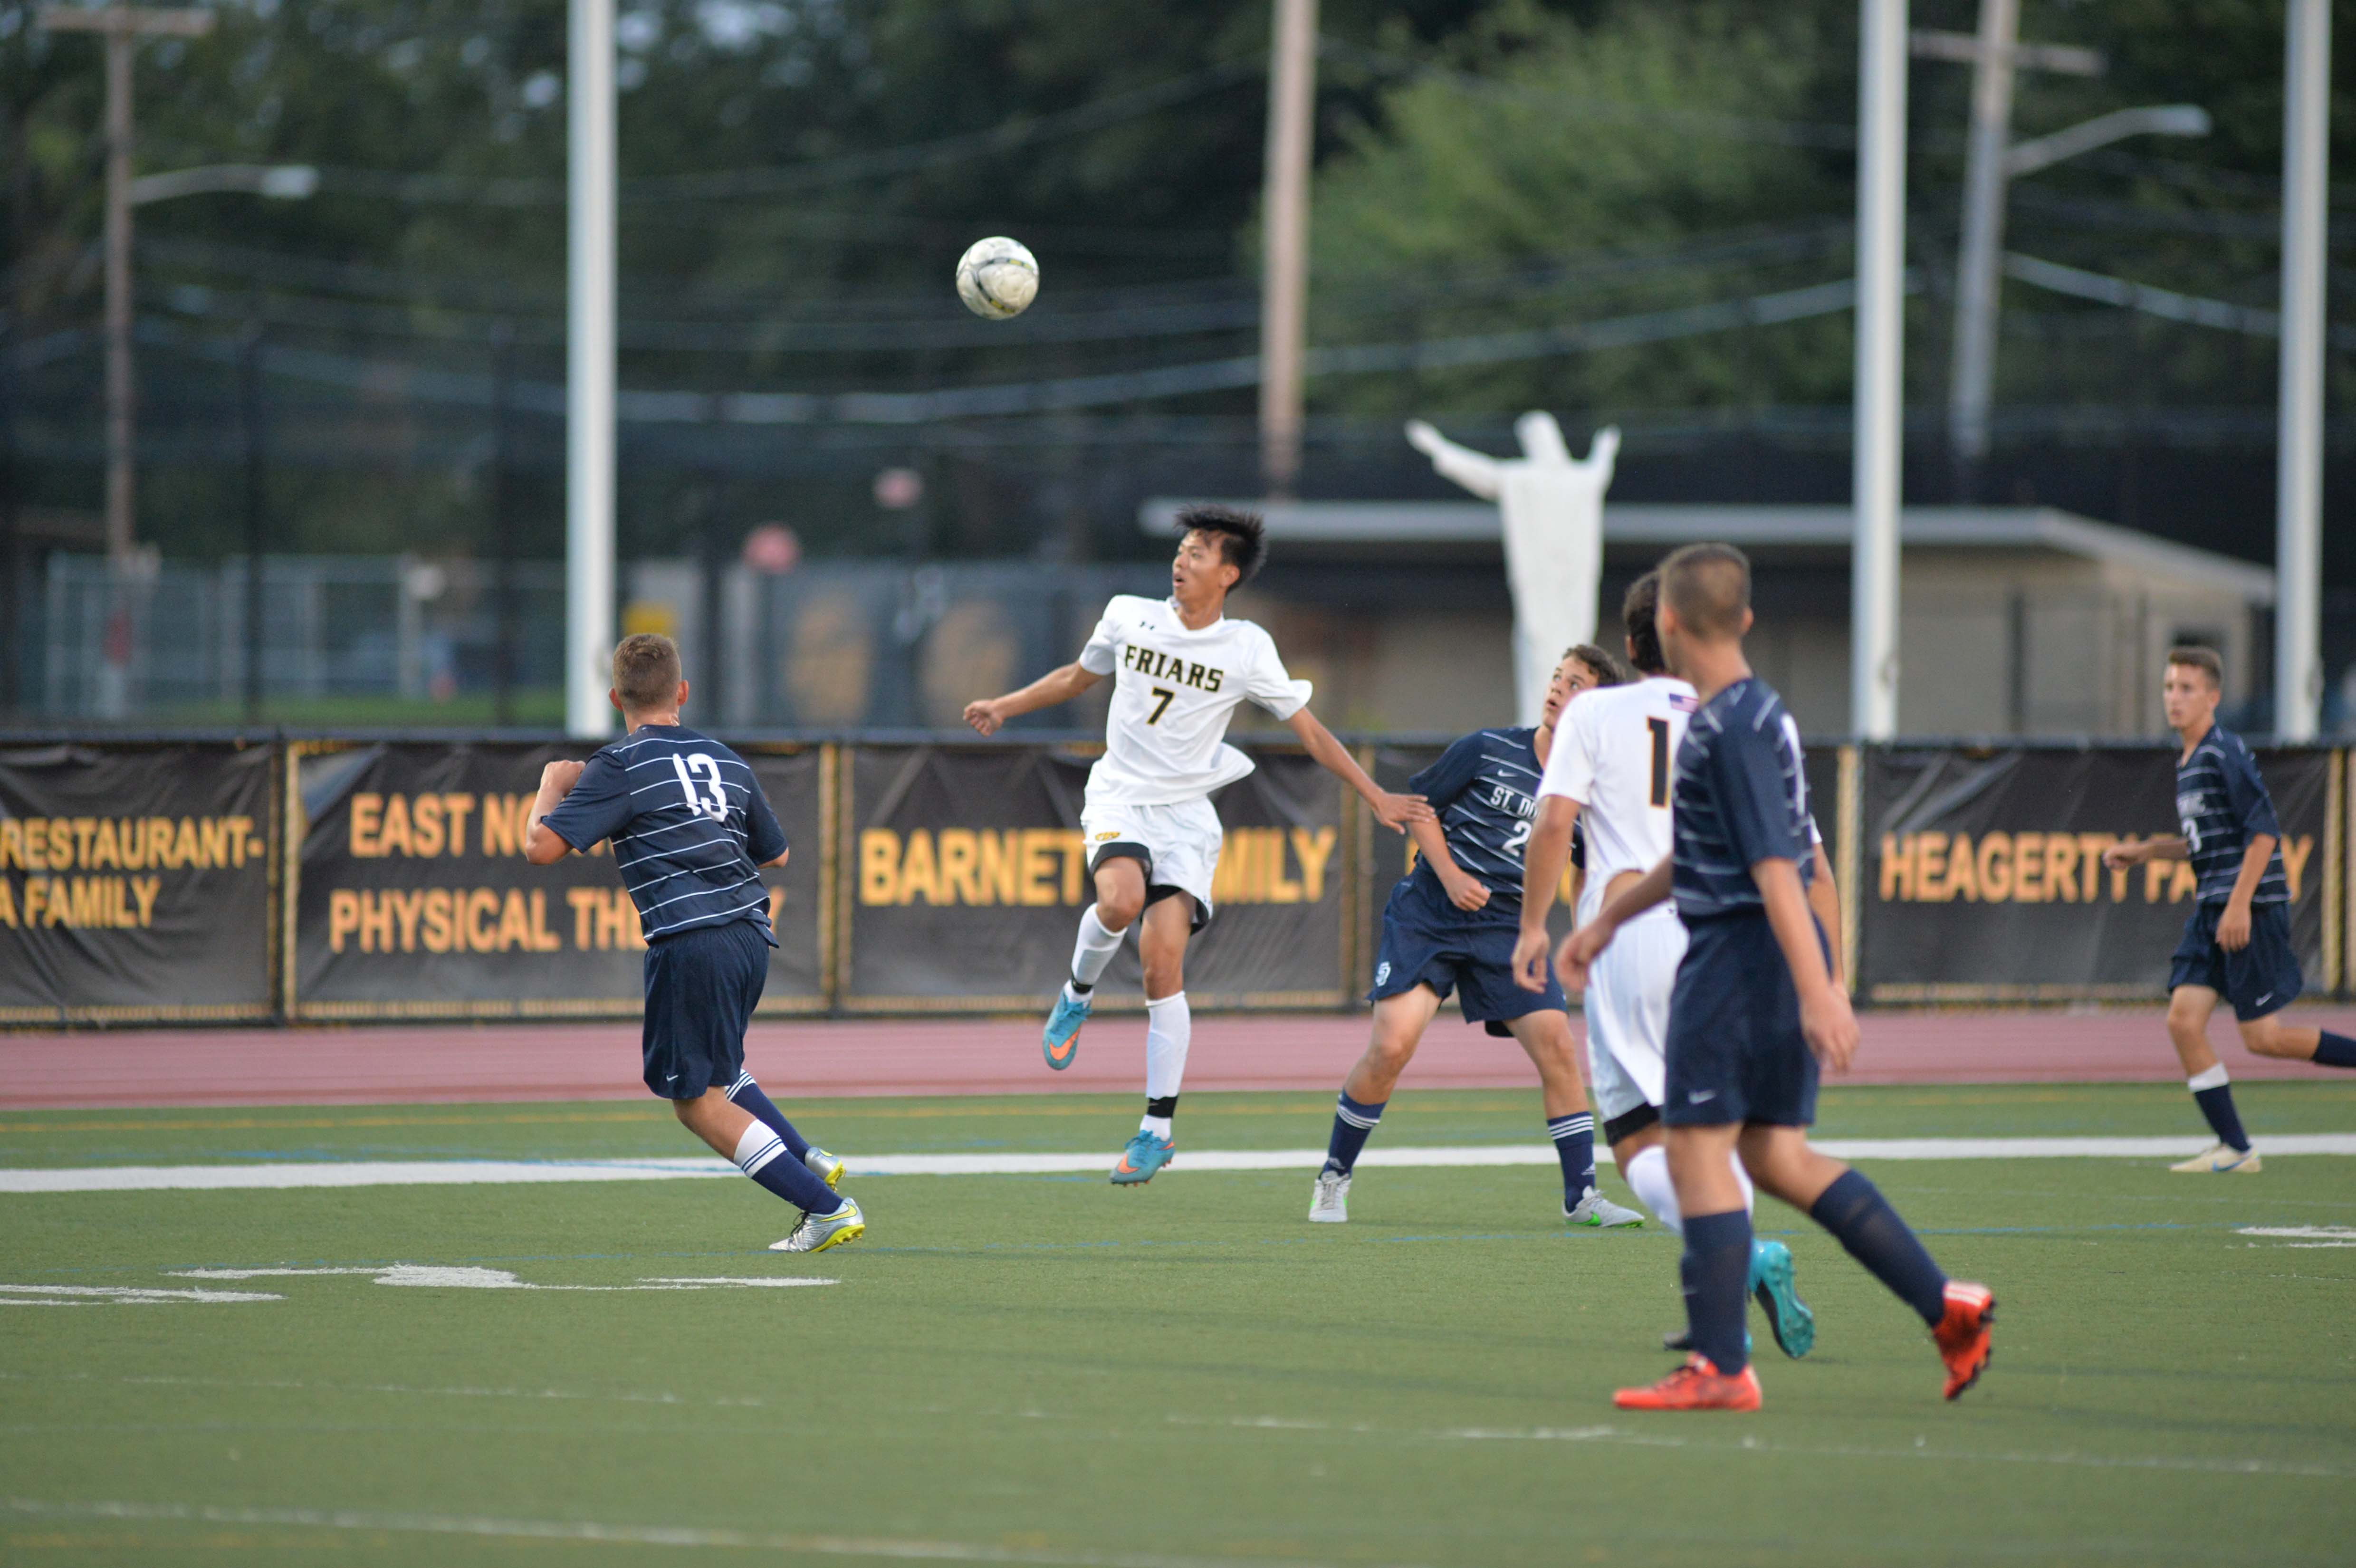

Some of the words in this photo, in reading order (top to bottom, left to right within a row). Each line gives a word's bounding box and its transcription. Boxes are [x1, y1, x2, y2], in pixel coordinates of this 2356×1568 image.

[1124, 644, 1224, 693] FRIARS
[1146, 686, 1175, 725] 7
[672, 753, 729, 822] 13
[0, 816, 265, 870] RESTAURANT-
[350, 792, 476, 858] EAST
[1211, 826, 1337, 904] MILY
[1879, 831, 2137, 903] HEAGERTY
[24, 876, 162, 929] FAMILY
[329, 888, 561, 953] PHYSICAL
